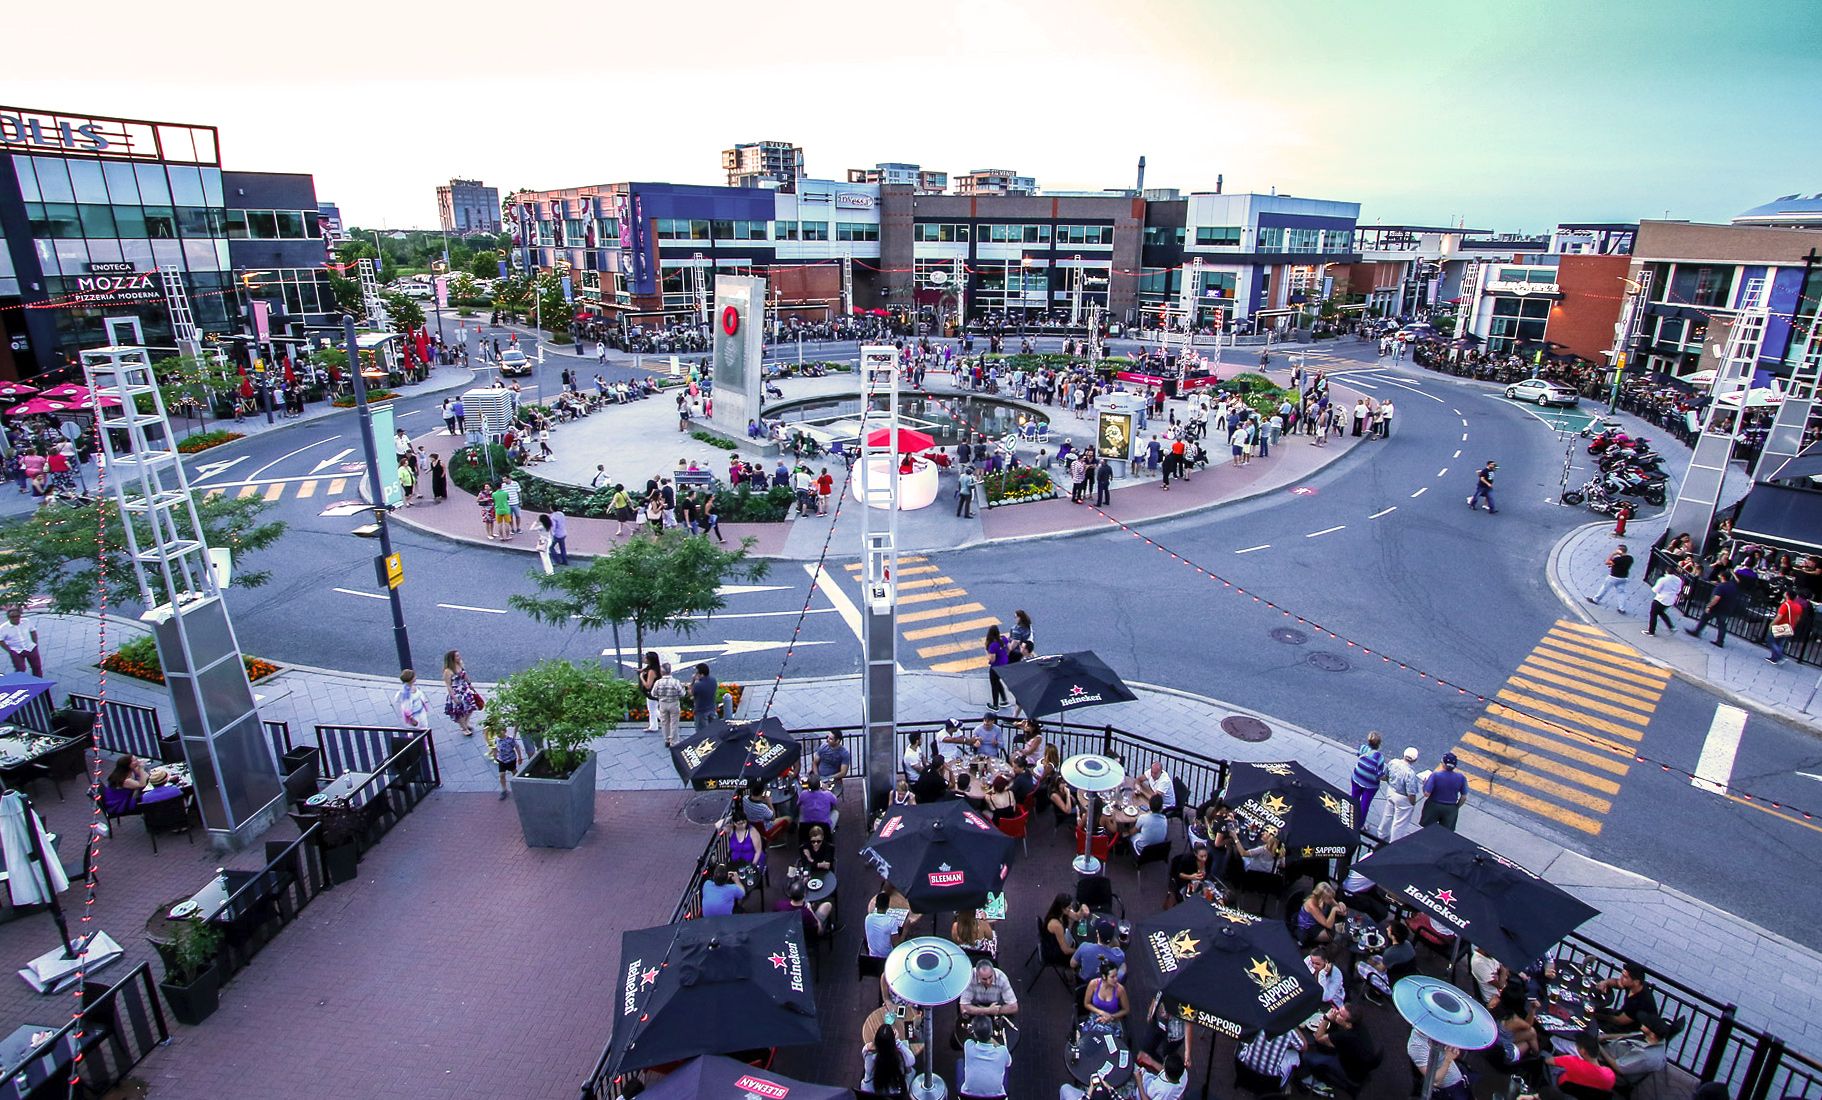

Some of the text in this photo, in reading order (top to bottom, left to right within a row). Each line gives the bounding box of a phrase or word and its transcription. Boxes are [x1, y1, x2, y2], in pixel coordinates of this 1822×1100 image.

[91, 263, 132, 272] ENOTECA
[78, 276, 154, 291] MOZZA
[75, 291, 161, 302] PIZZERIA MODERNA
[384, 481, 399, 504] P5
[1060, 694, 1102, 707] Heineken
[755, 743, 785, 766] SAPPORO
[1244, 798, 1286, 829] SAPPORO
[1314, 846, 1346, 854] SAPPORO
[931, 873, 962, 884] SLEEMAN
[1403, 884, 1468, 929] Heineken
[1153, 930, 1178, 972] SAPPORO
[788, 942, 804, 993] Heineken
[624, 958, 642, 1016] Heineken
[1258, 975, 1300, 1008] SAPPORO
[1267, 987, 1304, 1013] PREMIUM BEER
[1198, 1011, 1242, 1035] SAPPORO
[1198, 1020, 1224, 1033] PREMIUM
[740, 1077, 786, 1097] SLEEMAN
